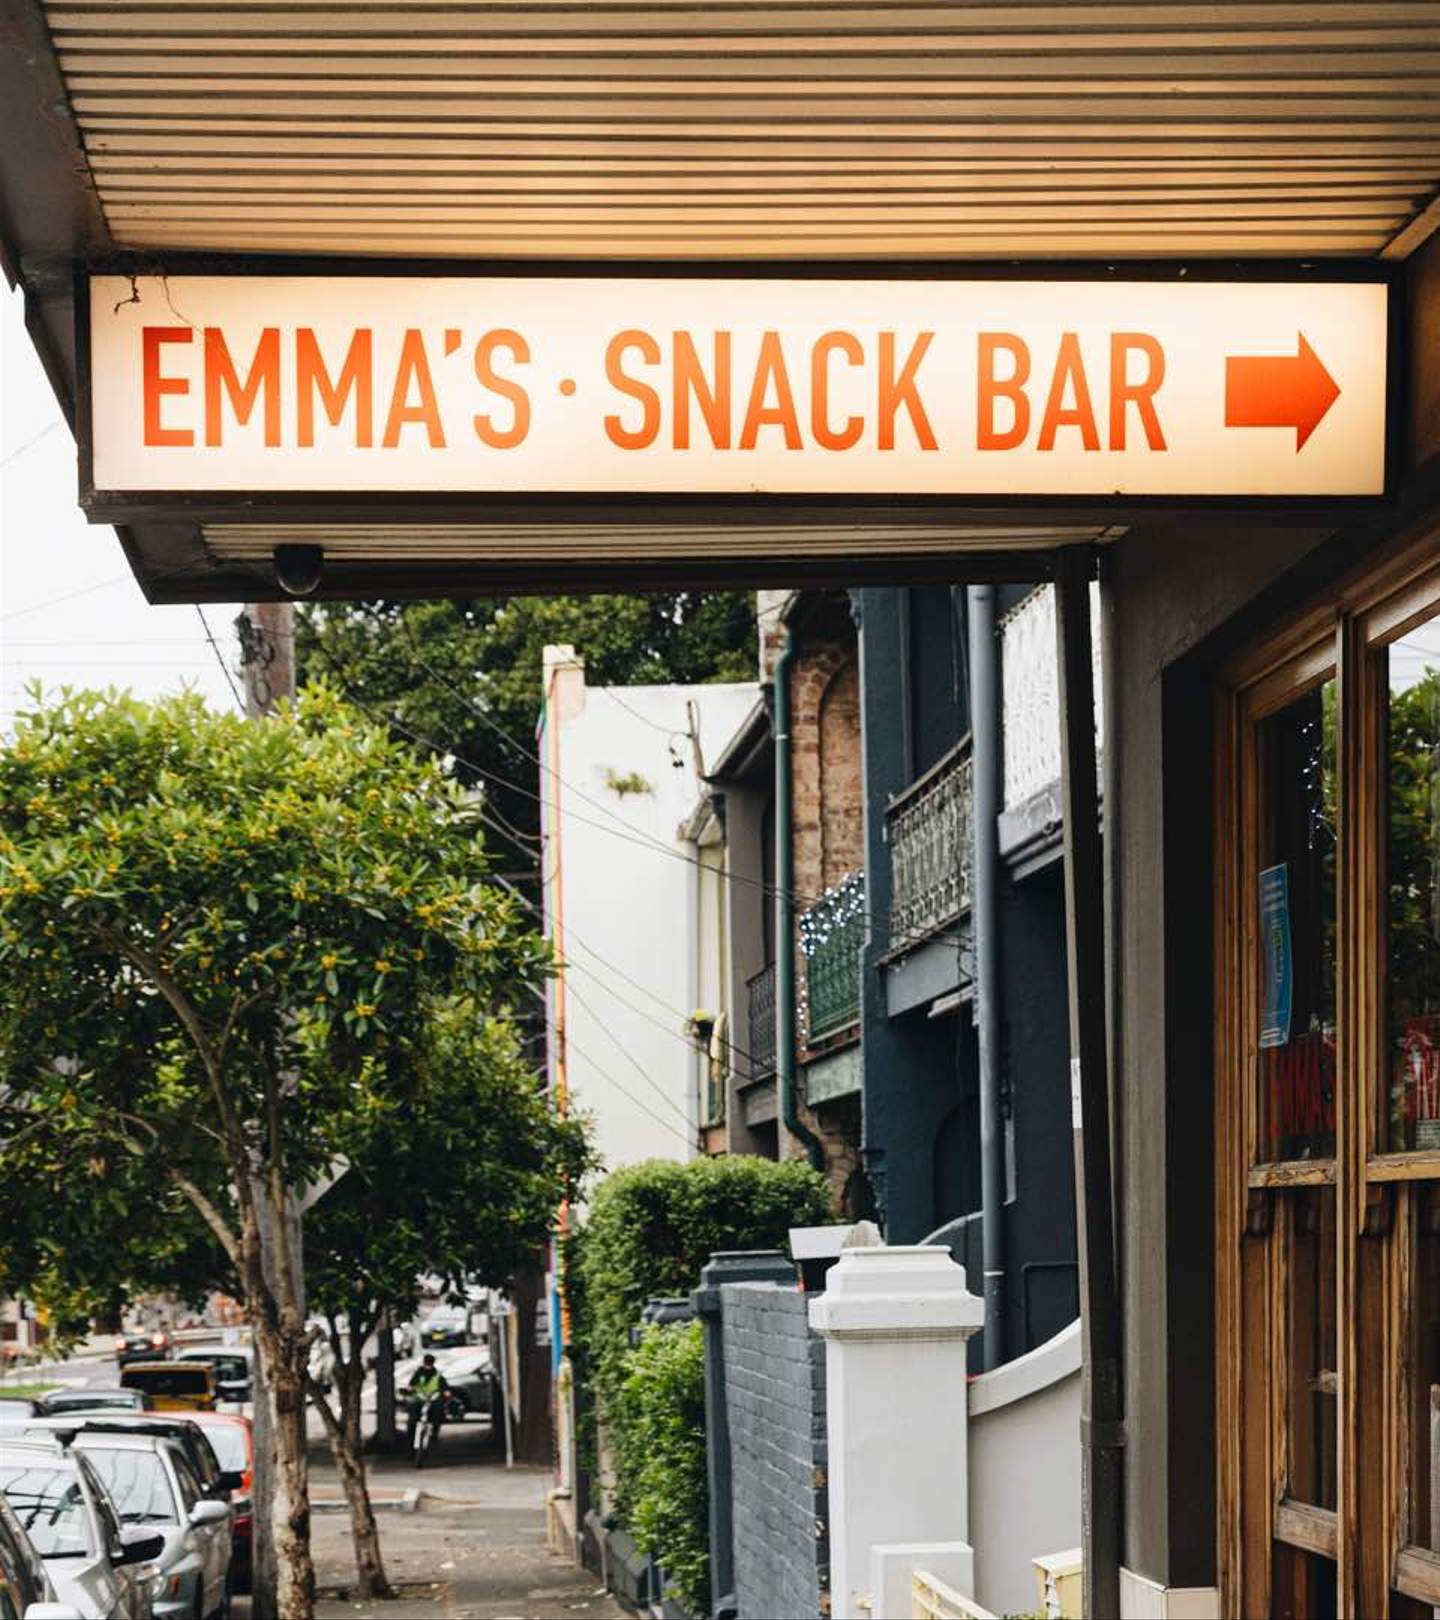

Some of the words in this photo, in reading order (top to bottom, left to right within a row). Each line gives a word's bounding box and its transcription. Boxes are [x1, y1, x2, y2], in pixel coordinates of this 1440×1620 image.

[141, 325, 530, 449] EMMA'S
[603, 330, 939, 452] SNACK
[975, 333, 1169, 452] BAR
